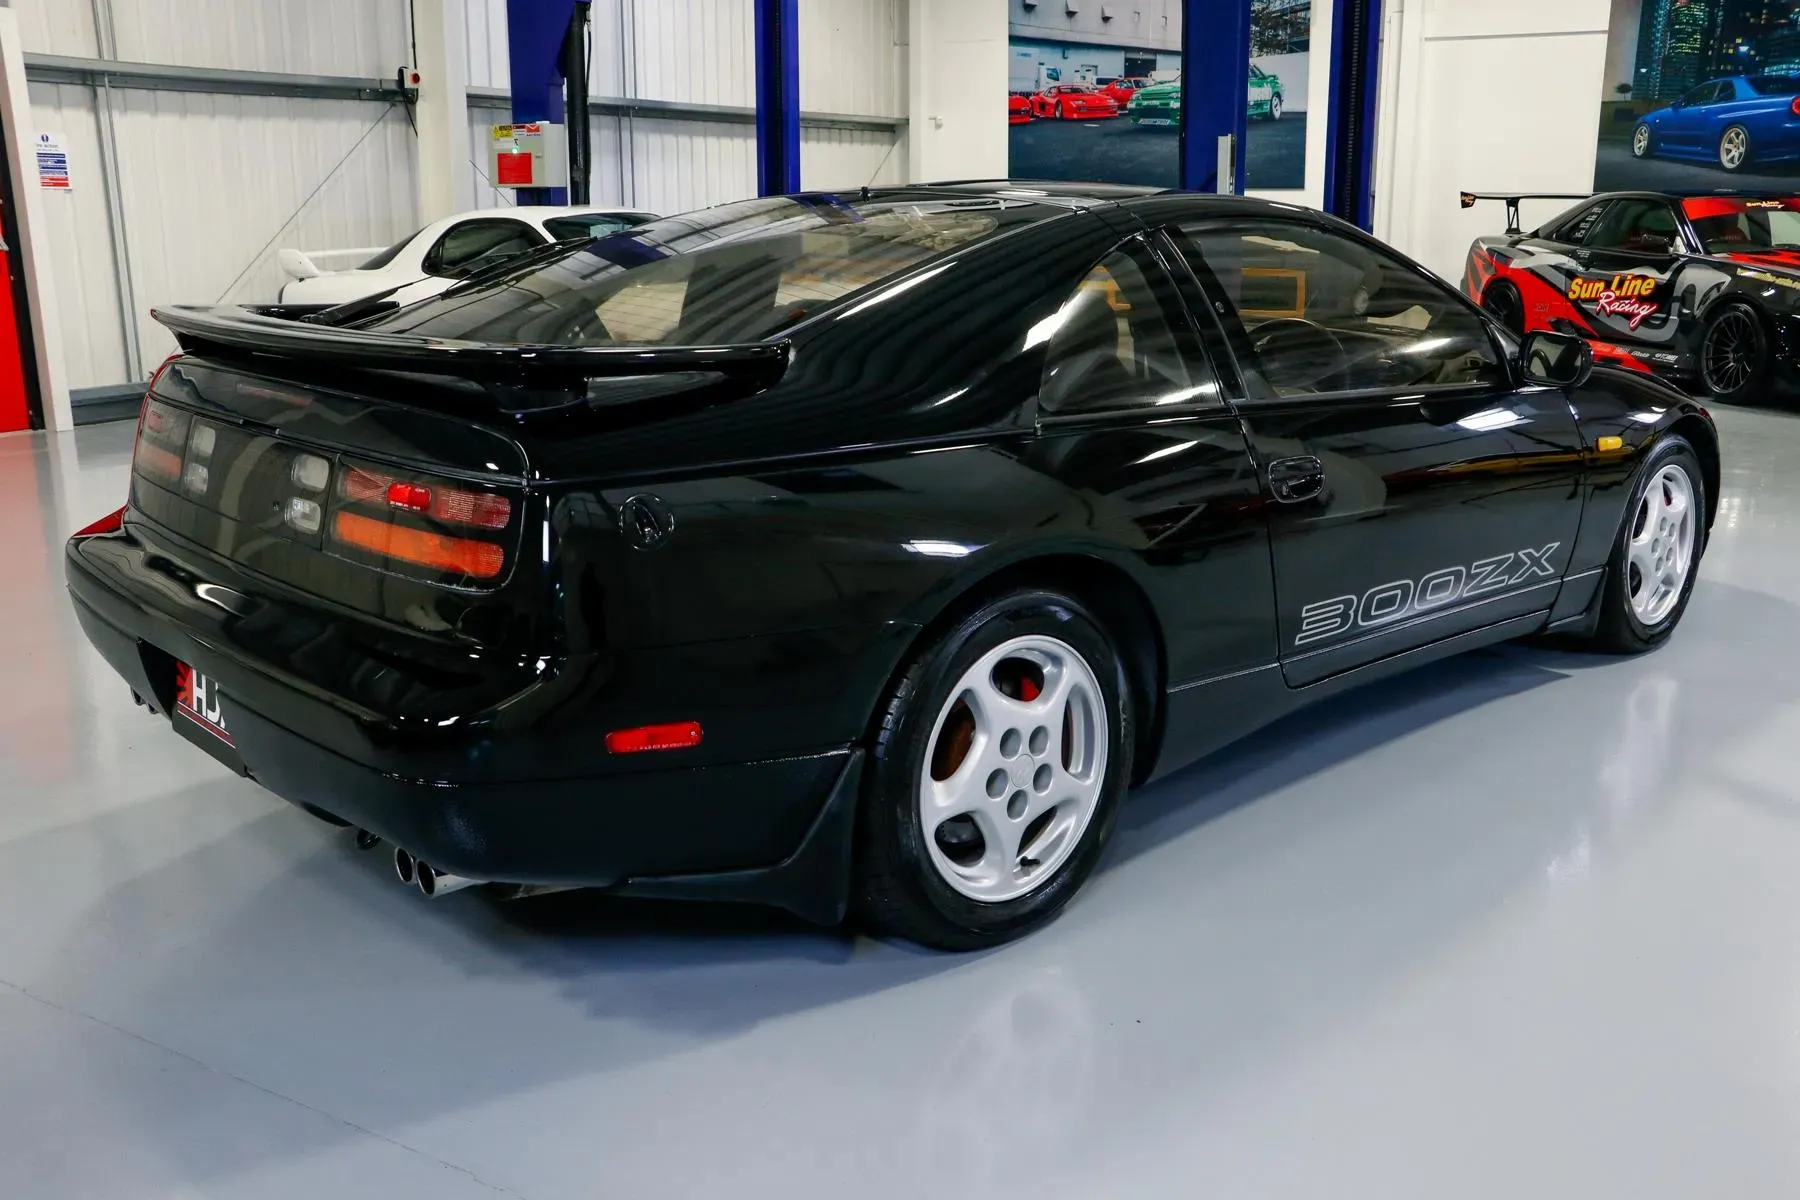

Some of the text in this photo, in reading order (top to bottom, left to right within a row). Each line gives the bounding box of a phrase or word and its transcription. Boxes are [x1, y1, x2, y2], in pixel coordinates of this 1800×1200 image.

[1568, 274, 1655, 299] Sun Line
[1597, 291, 1657, 328] Racing
[1295, 542, 1560, 645] 300ZX
[192, 668, 226, 730] HJ
